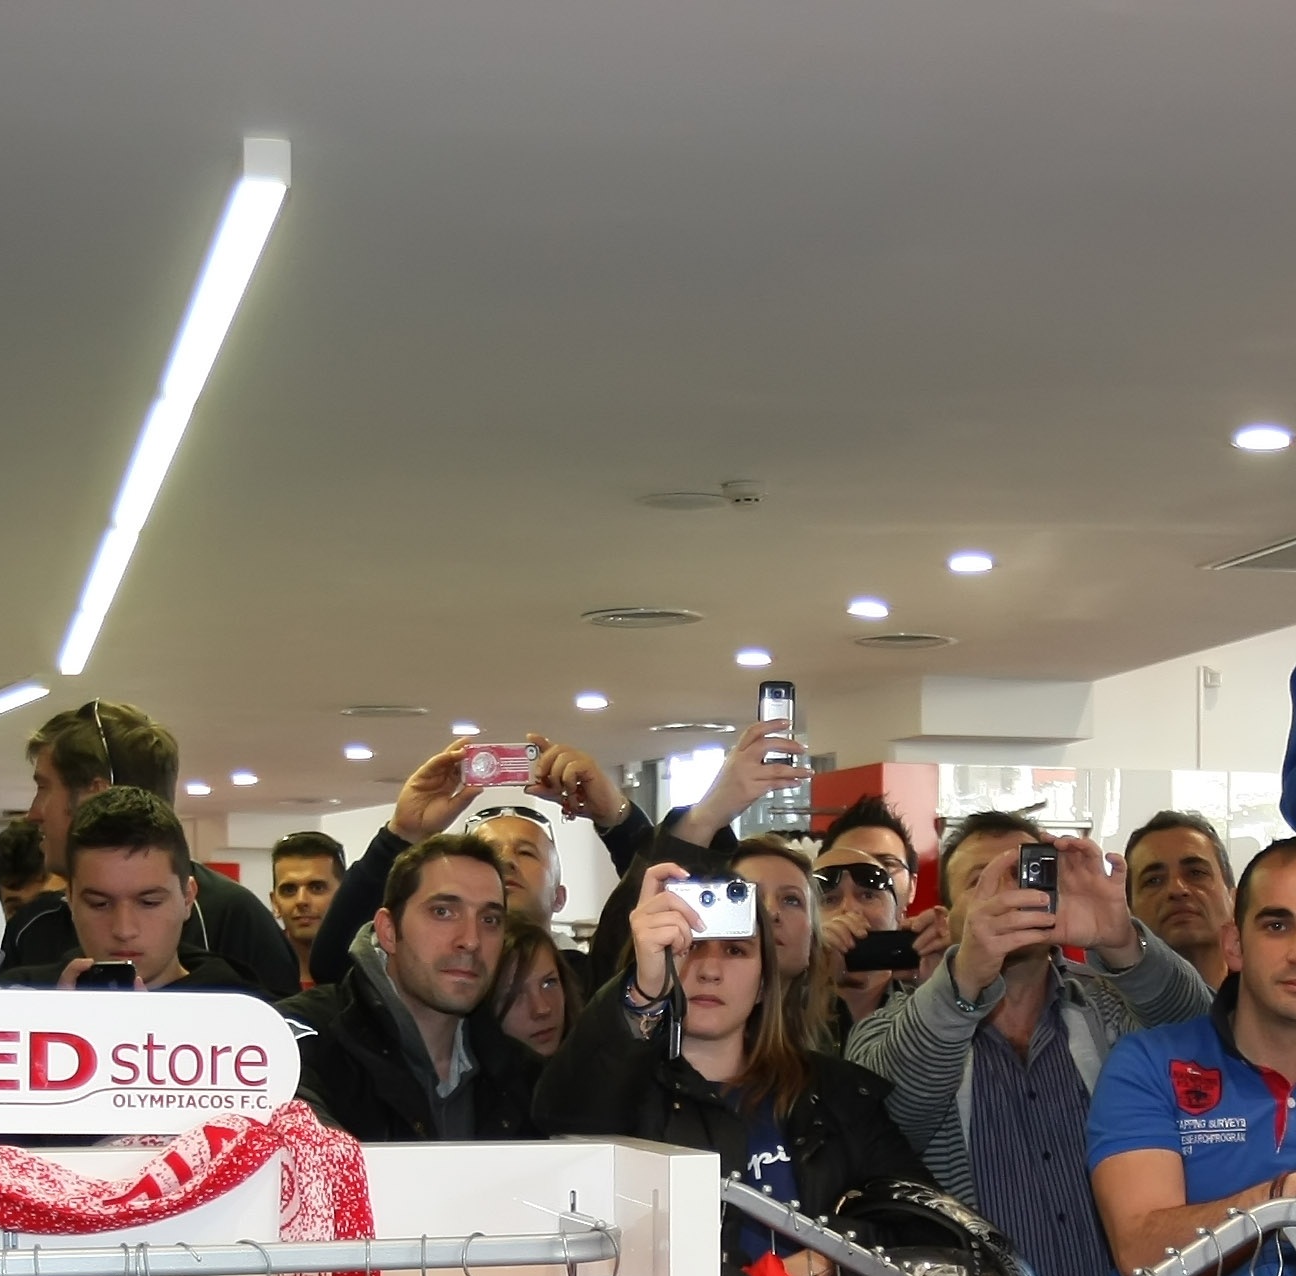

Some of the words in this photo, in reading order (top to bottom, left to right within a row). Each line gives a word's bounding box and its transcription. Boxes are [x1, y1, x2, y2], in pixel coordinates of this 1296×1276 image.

[110, 1032, 268, 1087] store
[112, 1094, 235, 1110] OLYMPIACOS
[240, 1094, 273, 1110] F.C.
